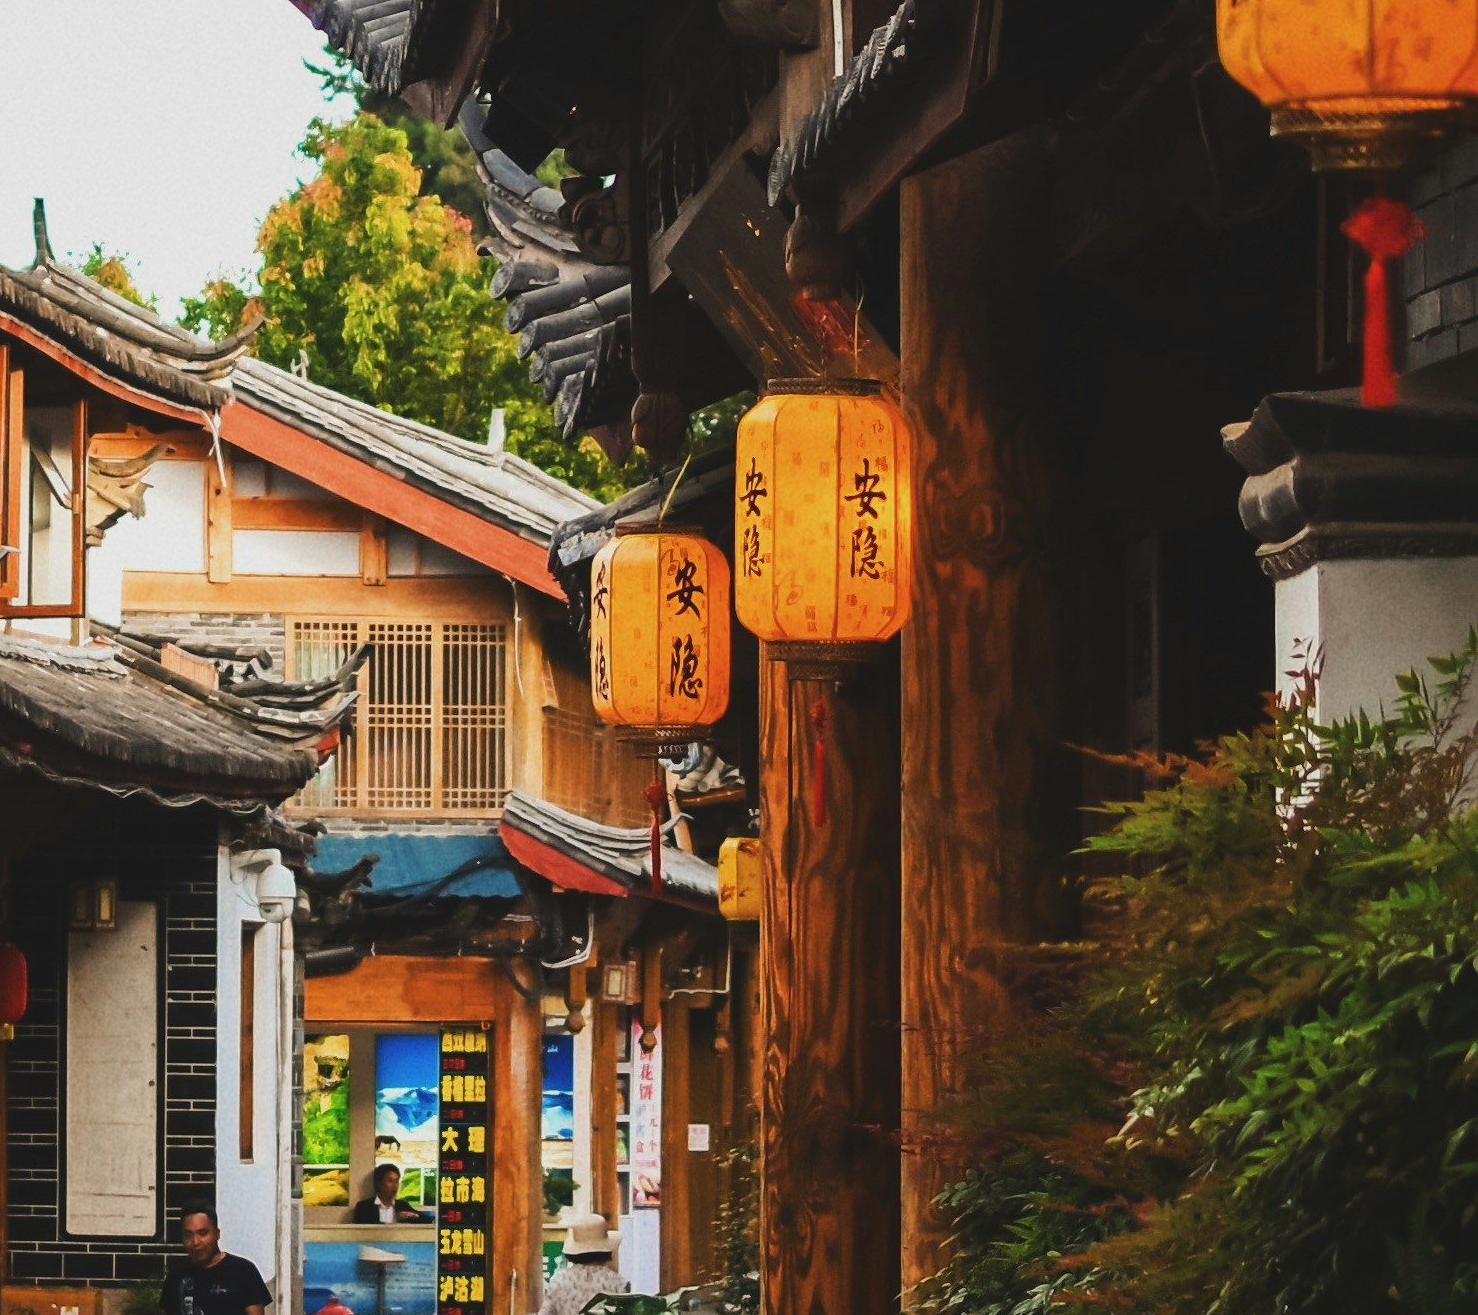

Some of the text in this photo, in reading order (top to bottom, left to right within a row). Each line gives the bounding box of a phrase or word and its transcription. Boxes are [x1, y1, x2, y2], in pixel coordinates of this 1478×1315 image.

[738, 457, 768, 578] 安隐
[844, 457, 887, 581] 安隐
[592, 560, 610, 701] 安隐
[666, 558, 706, 699] 安隐
[441, 1126, 485, 1153] 大理
[440, 1176, 485, 1203] 拉市海
[440, 1229, 485, 1255] 玉龙雪山
[439, 1276, 484, 1302] 泸沽湖
